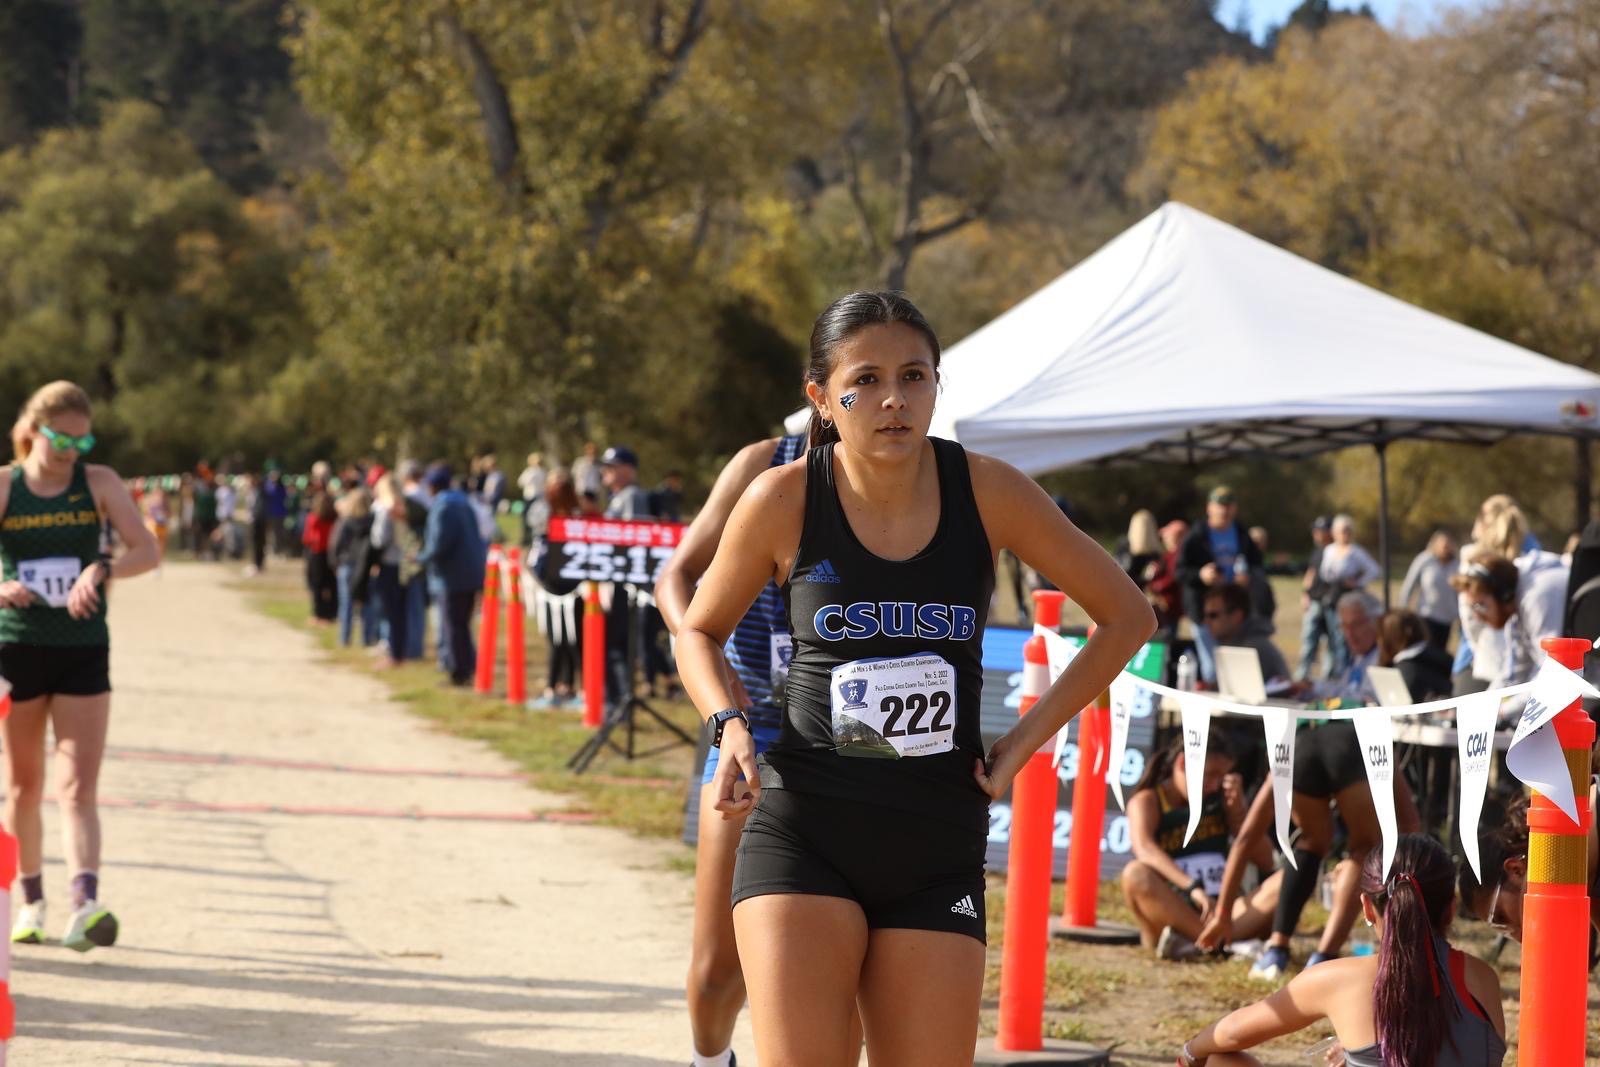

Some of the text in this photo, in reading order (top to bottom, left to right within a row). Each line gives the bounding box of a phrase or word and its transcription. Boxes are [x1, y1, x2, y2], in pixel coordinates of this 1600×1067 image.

[805, 573, 841, 584] adidas
[813, 601, 977, 642] CSUSB
[880, 690, 952, 738] 222
[1368, 744, 1389, 767] CCAA
[1466, 731, 1488, 758] CCAA
[951, 906, 977, 919] adidas
